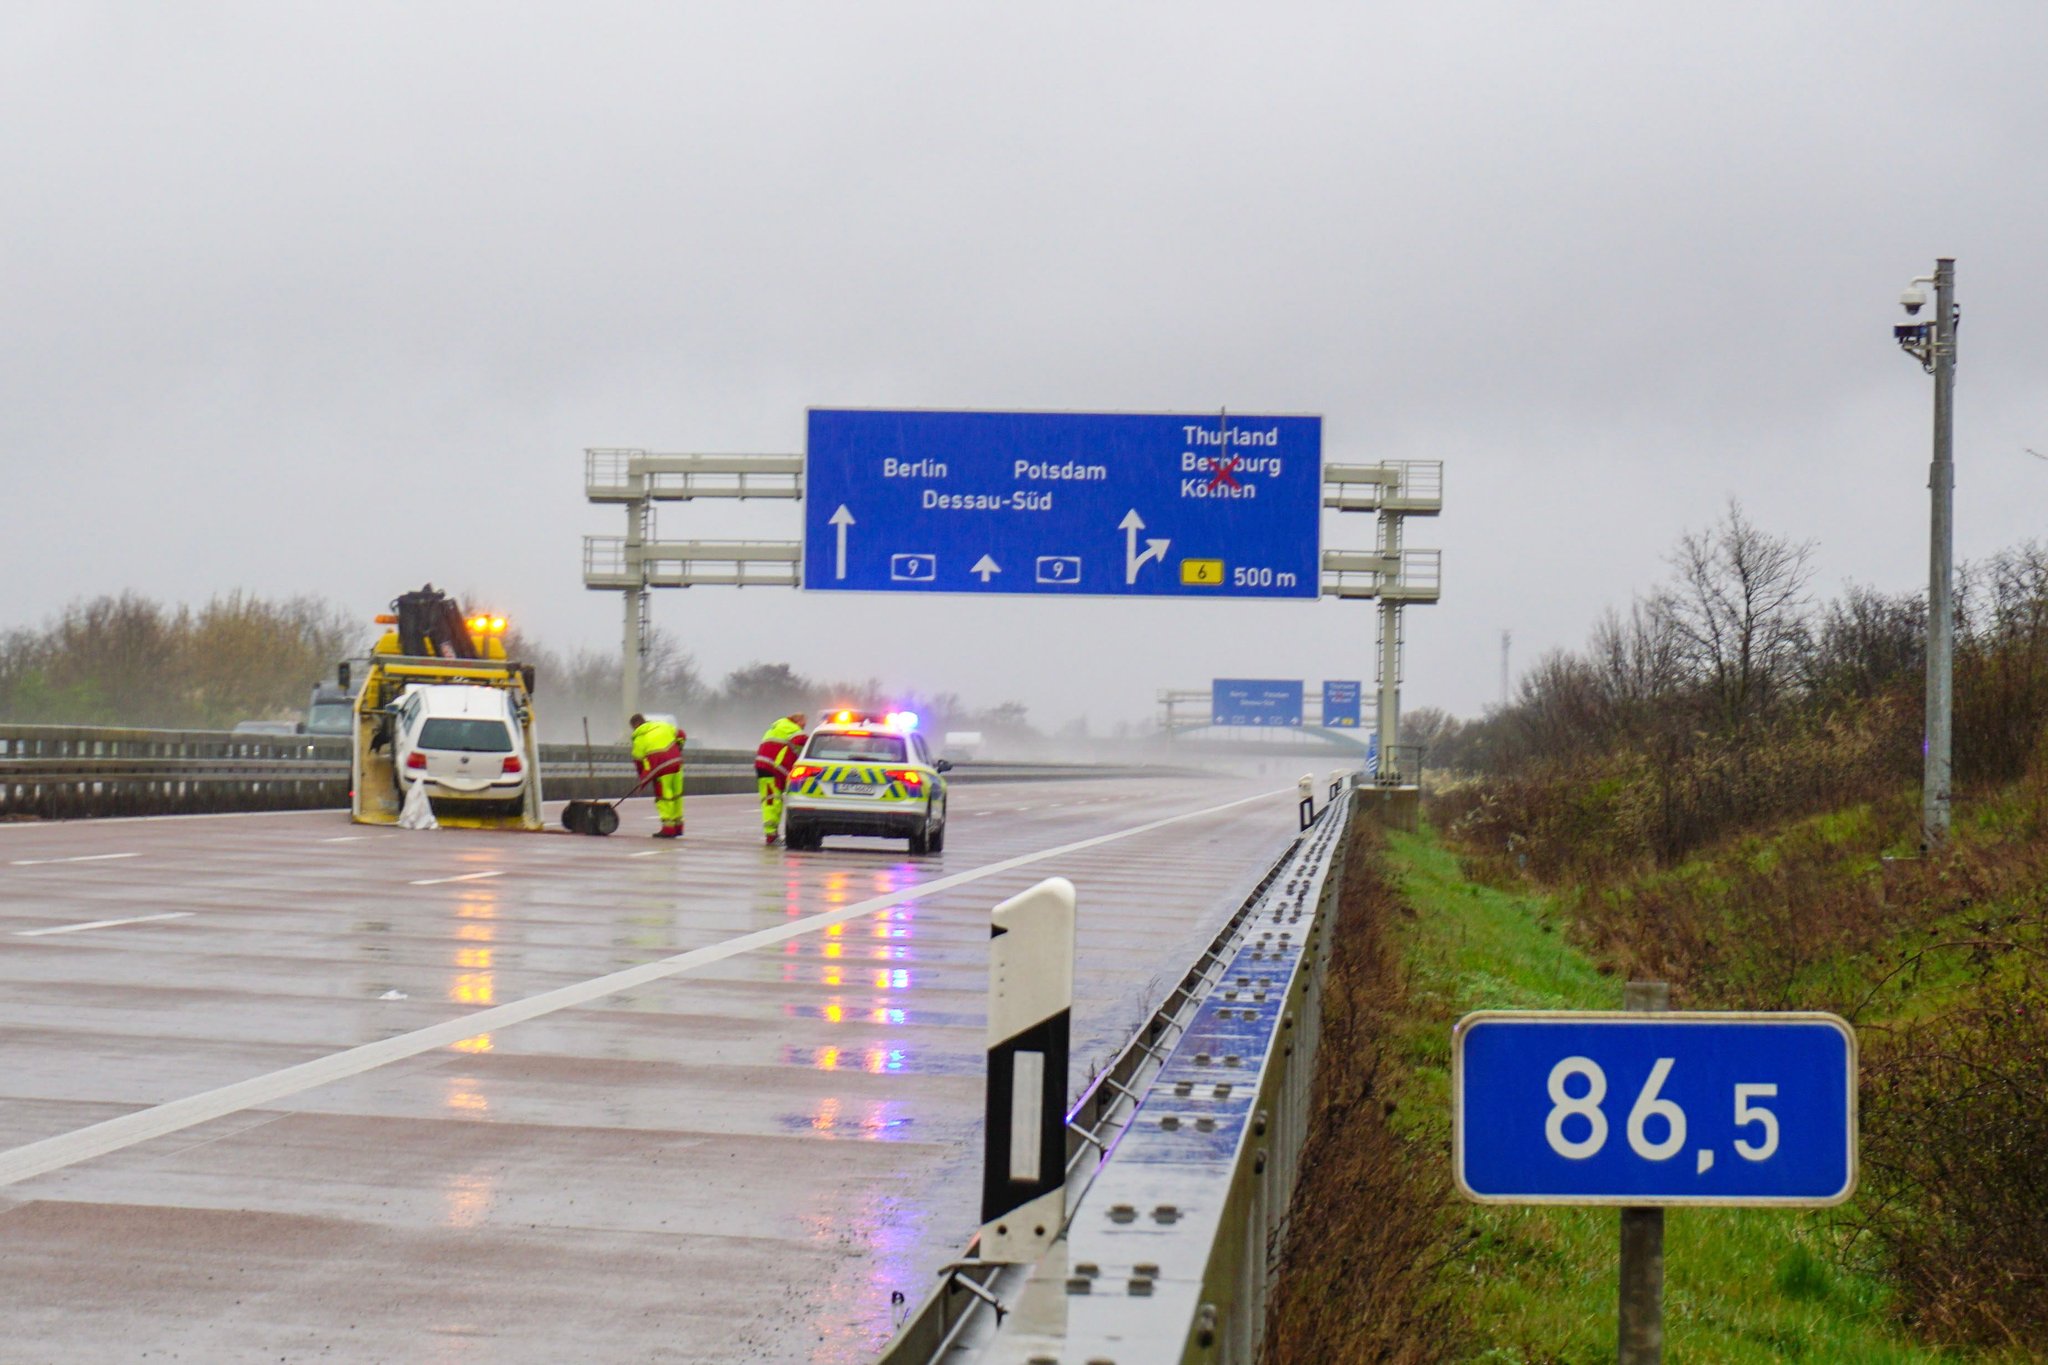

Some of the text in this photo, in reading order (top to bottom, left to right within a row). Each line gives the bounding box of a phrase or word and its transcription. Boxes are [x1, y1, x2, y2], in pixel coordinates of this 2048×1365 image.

[1183, 425, 1278, 446] Thurland
[883, 458, 947, 478] Berlin
[1014, 460, 1106, 480] Potsdam
[922, 489, 1052, 511] Dessau-Süd
[908, 560, 919, 575] 9
[1053, 561, 1064, 578] 9
[1198, 564, 1207, 579] 6
[1234, 567, 1296, 587] 500 m
[1545, 1056, 1780, 1175] 86,5
